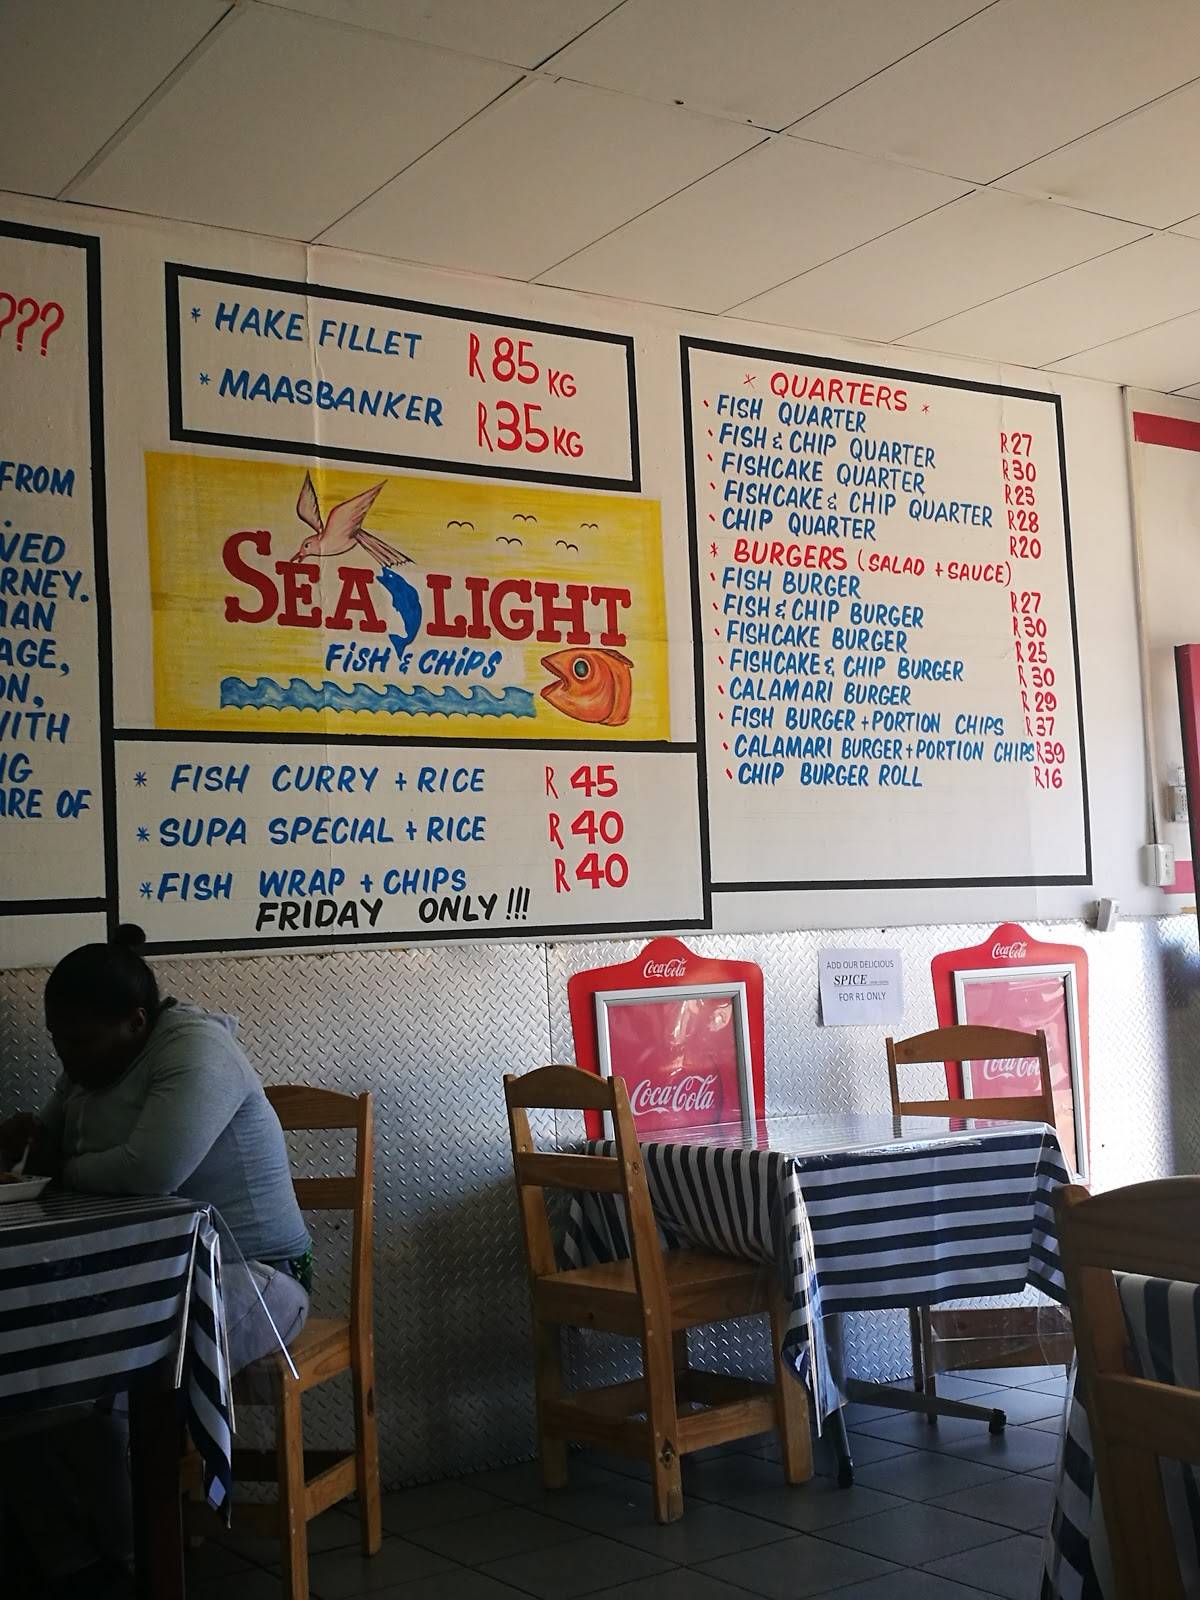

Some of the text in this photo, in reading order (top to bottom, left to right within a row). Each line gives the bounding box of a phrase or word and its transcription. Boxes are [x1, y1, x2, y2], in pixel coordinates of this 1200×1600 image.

[215, 302, 304, 342] HAKE
[318, 319, 422, 360] FILLET
[218, 368, 443, 427] MAASBANKER
[770, 372, 908, 412] QUARTERS
[717, 394, 763, 421] FISH
[778, 401, 866, 433] QUARTER
[719, 423, 767, 450] FISH
[789, 430, 837, 456] CHIP
[850, 437, 936, 469] QUARTER
[0, 460, 75, 498] FROM
[721, 451, 823, 482] FISHCAKE
[836, 463, 925, 496] QUARTER
[849, 491, 897, 516] CHIP
[908, 499, 993, 528] QUARTER
[1007, 509, 1039, 533] R28
[722, 507, 1041, 559] CHIP QUARTER R20
[734, 538, 848, 571] BURGERS
[722, 567, 772, 593] FISH
[782, 570, 861, 599] BURGER
[426, 573, 632, 647] LIGHT
[723, 593, 770, 618] FISH
[791, 598, 840, 623] CHIP
[850, 602, 924, 629] BURGER
[727, 620, 820, 648] FISHCAKE
[832, 627, 907, 654] BURGER
[843, 655, 886, 679] CHIP
[897, 657, 964, 682] BURGER
[729, 676, 834, 703] CALAMARI
[844, 682, 911, 706] BURGER
[731, 705, 774, 729] FISH
[785, 707, 856, 732] BURGER
[955, 714, 1004, 737] CHIPS
[734, 734, 832, 760] CALAMARI
[993, 741, 1034, 763] CHIPS
[1036, 741, 1065, 764] R39
[170, 764, 250, 793] FISH
[272, 764, 379, 793] CURRY
[417, 766, 485, 793] RICE
[738, 762, 1064, 789] CHIP BURGER ROLL R16
[56, 790, 92, 819] OF
[159, 817, 247, 847] SUPA
[268, 816, 394, 845] SPECIAL
[427, 816, 486, 842] RICE
[157, 872, 233, 903] FISH
[259, 868, 345, 898] WRAP
[383, 867, 466, 896] CHIPS
[255, 897, 384, 932] FRIDAY
[643, 958, 687, 979] Coca-Cola
[826, 959, 894, 969] ADD OUR DELICIOUS
[833, 974, 868, 986] SPICE
[839, 991, 887, 1002] FOR R1 ONLY
[630, 1075, 718, 1116] Coca-Cola
